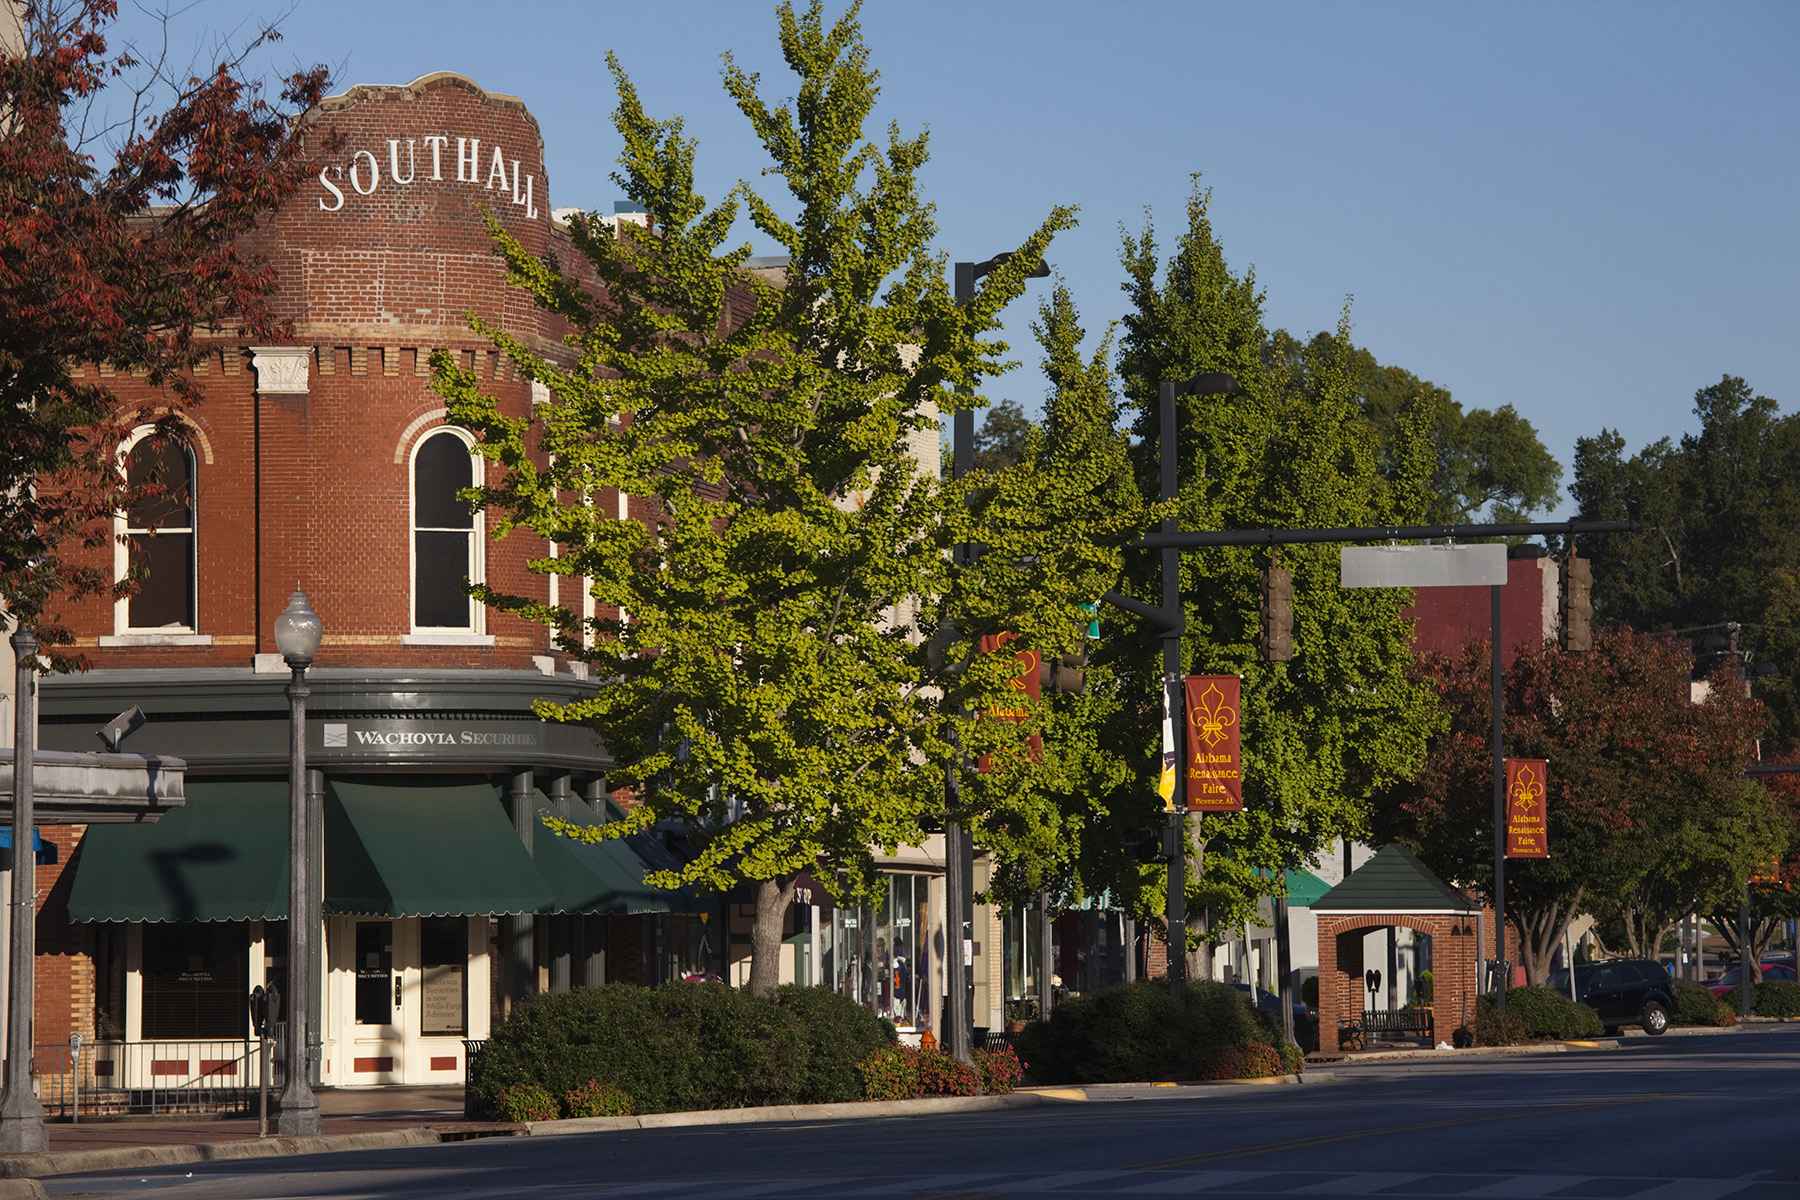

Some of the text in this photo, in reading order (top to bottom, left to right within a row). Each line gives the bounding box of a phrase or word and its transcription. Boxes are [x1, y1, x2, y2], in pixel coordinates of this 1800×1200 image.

[318, 136, 538, 219] SOUTHALL
[354, 730, 457, 745] WACHOVIA
[1195, 752, 1232, 763] Alabama
[1202, 783, 1227, 794] Faire
